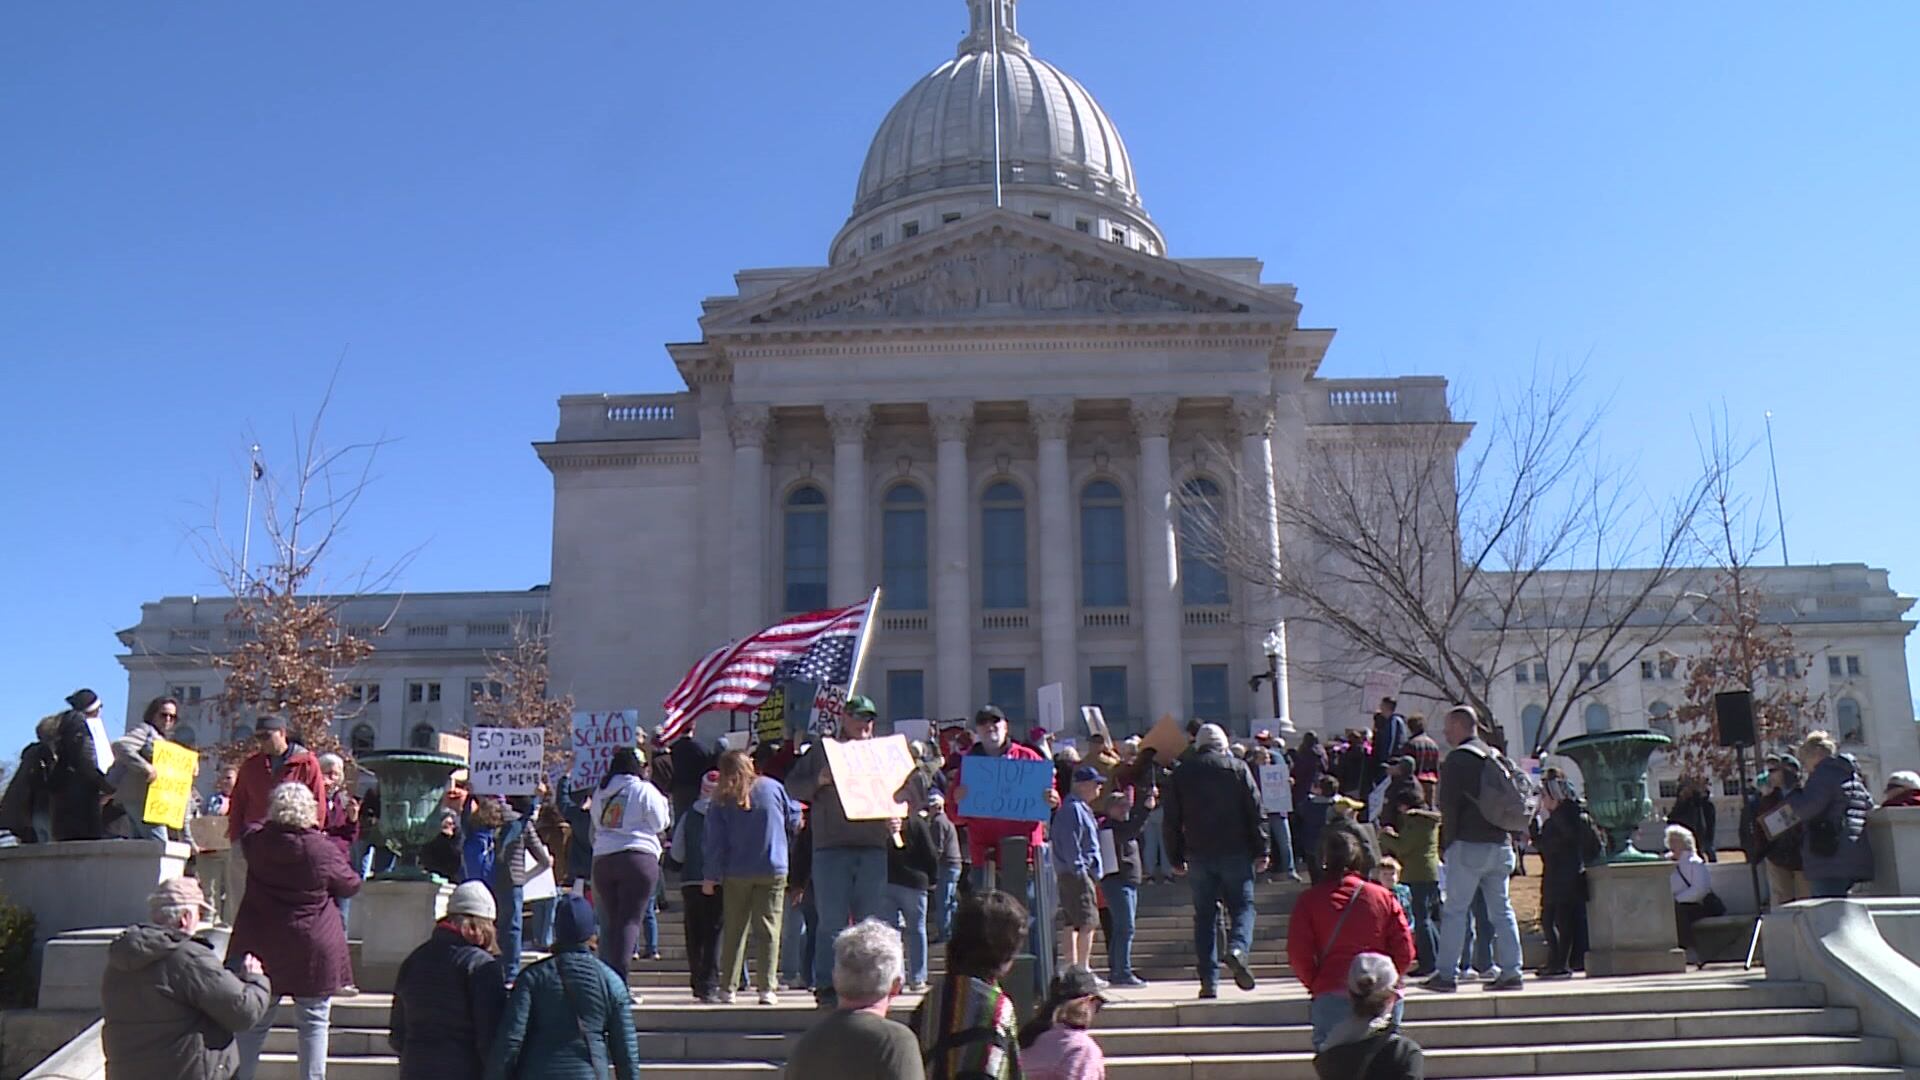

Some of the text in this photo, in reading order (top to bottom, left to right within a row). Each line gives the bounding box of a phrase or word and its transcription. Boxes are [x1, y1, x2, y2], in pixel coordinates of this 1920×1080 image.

[477, 731, 541, 749] SO BAD
[575, 725, 633, 747] SCARED
[488, 773, 502, 786] IS
[976, 760, 1036, 785] STOP
[973, 791, 1037, 815] COUP
